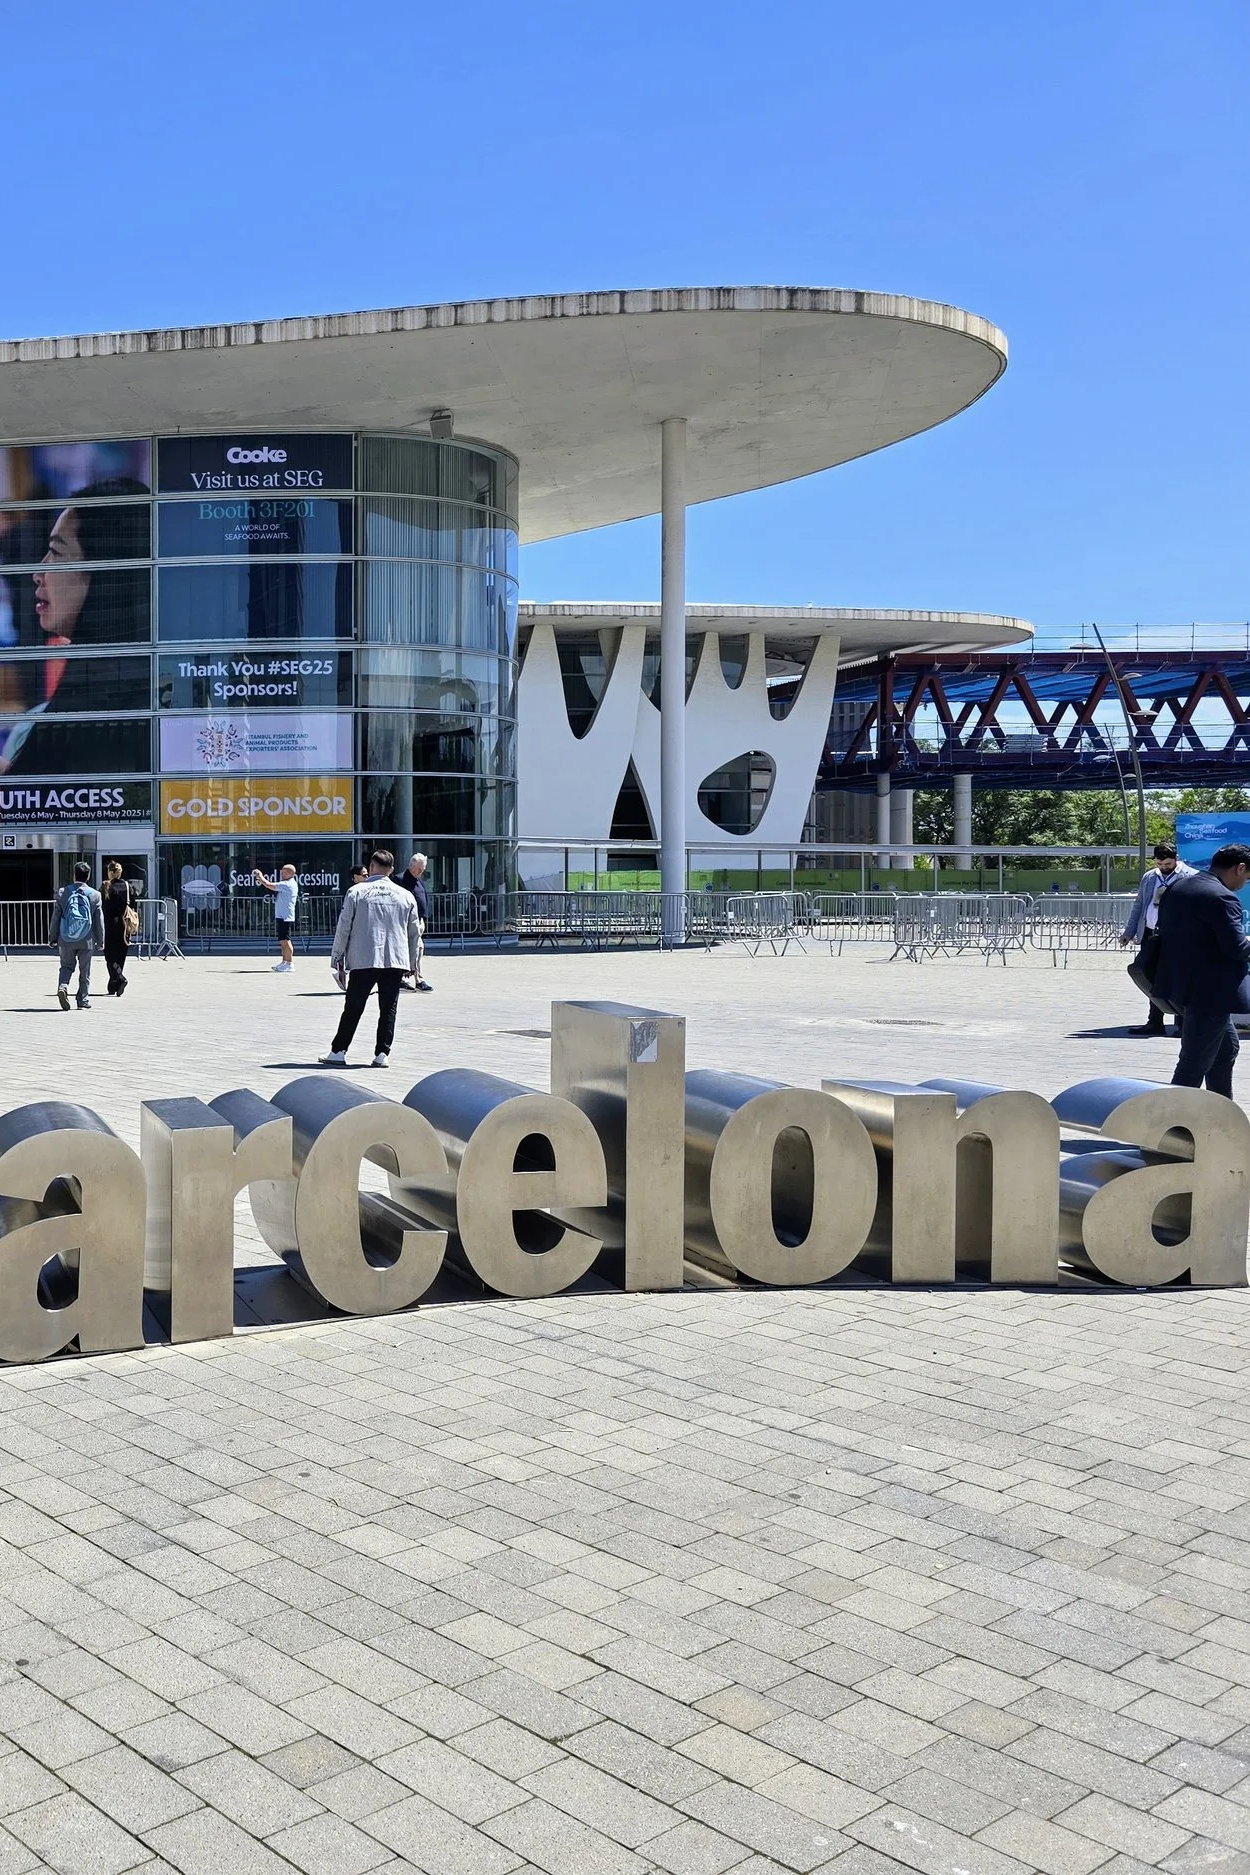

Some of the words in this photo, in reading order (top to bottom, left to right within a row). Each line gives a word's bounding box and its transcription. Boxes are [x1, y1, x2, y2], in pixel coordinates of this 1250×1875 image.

[226, 446, 288, 464] Cooke
[190, 470, 233, 489] Visit
[237, 474, 259, 488] us
[262, 472, 281, 487] at
[284, 469, 324, 487] SEG
[199, 502, 256, 520] Booth
[259, 501, 316, 518] 3F201
[269, 523, 280, 531] OF
[224, 533, 260, 541] SEAFOOD
[178, 661, 229, 677] Thank
[231, 660, 265, 676] You
[267, 660, 333, 675] #SEG25
[213, 681, 298, 700] Sponsors!
[44, 787, 126, 809] ACCESS
[166, 798, 235, 818] GOLD
[237, 795, 348, 817] SPONSOR
[31, 811, 37, 819] 6
[37, 810, 55, 820] May
[59, 810, 96, 820] Thursday
[96, 810, 102, 818] 8
[103, 809, 121, 819] May
[121, 809, 142, 817] 2025
